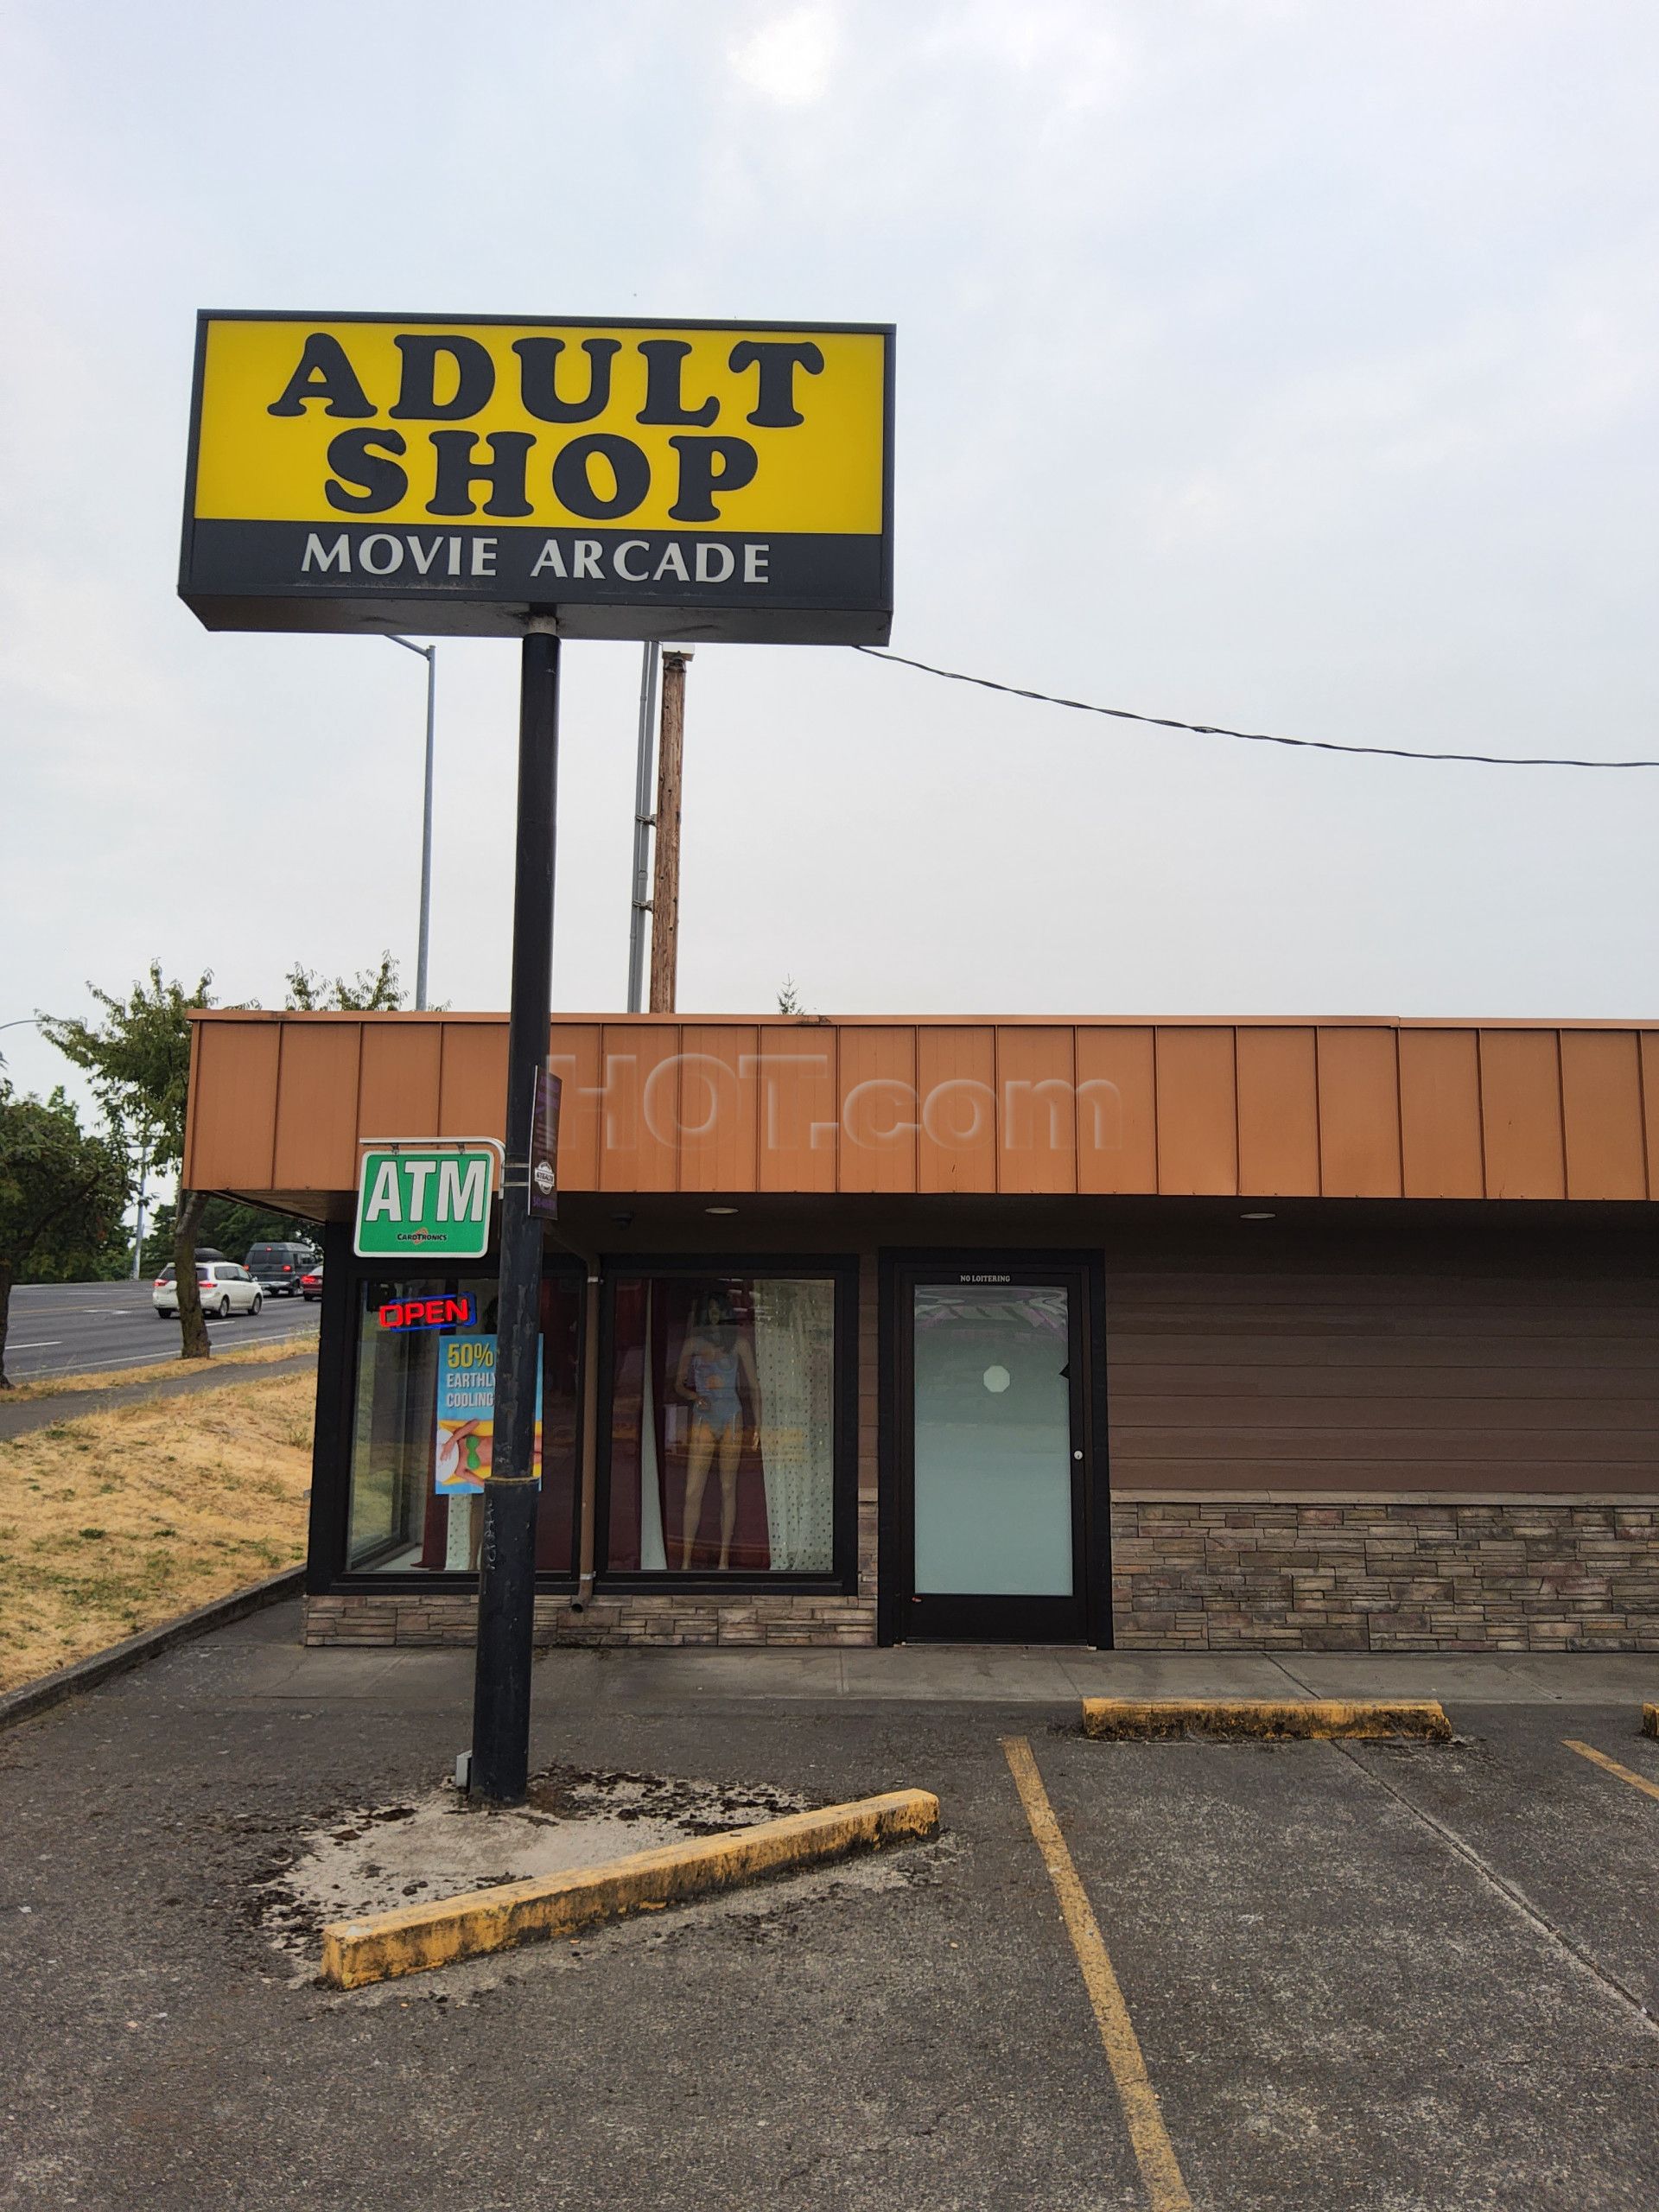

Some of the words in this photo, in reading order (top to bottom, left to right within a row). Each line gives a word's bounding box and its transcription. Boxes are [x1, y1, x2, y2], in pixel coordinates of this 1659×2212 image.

[267, 332, 824, 427] ADULT
[324, 427, 758, 522] SHOP
[301, 532, 498, 576] MOVIE
[530, 537, 769, 584] ARCADE
[365, 1160, 486, 1223] ATM
[378, 1299, 469, 1328] OPEN
[448, 1342, 494, 1369] 50%
[446, 1392, 495, 1408] COOLING
